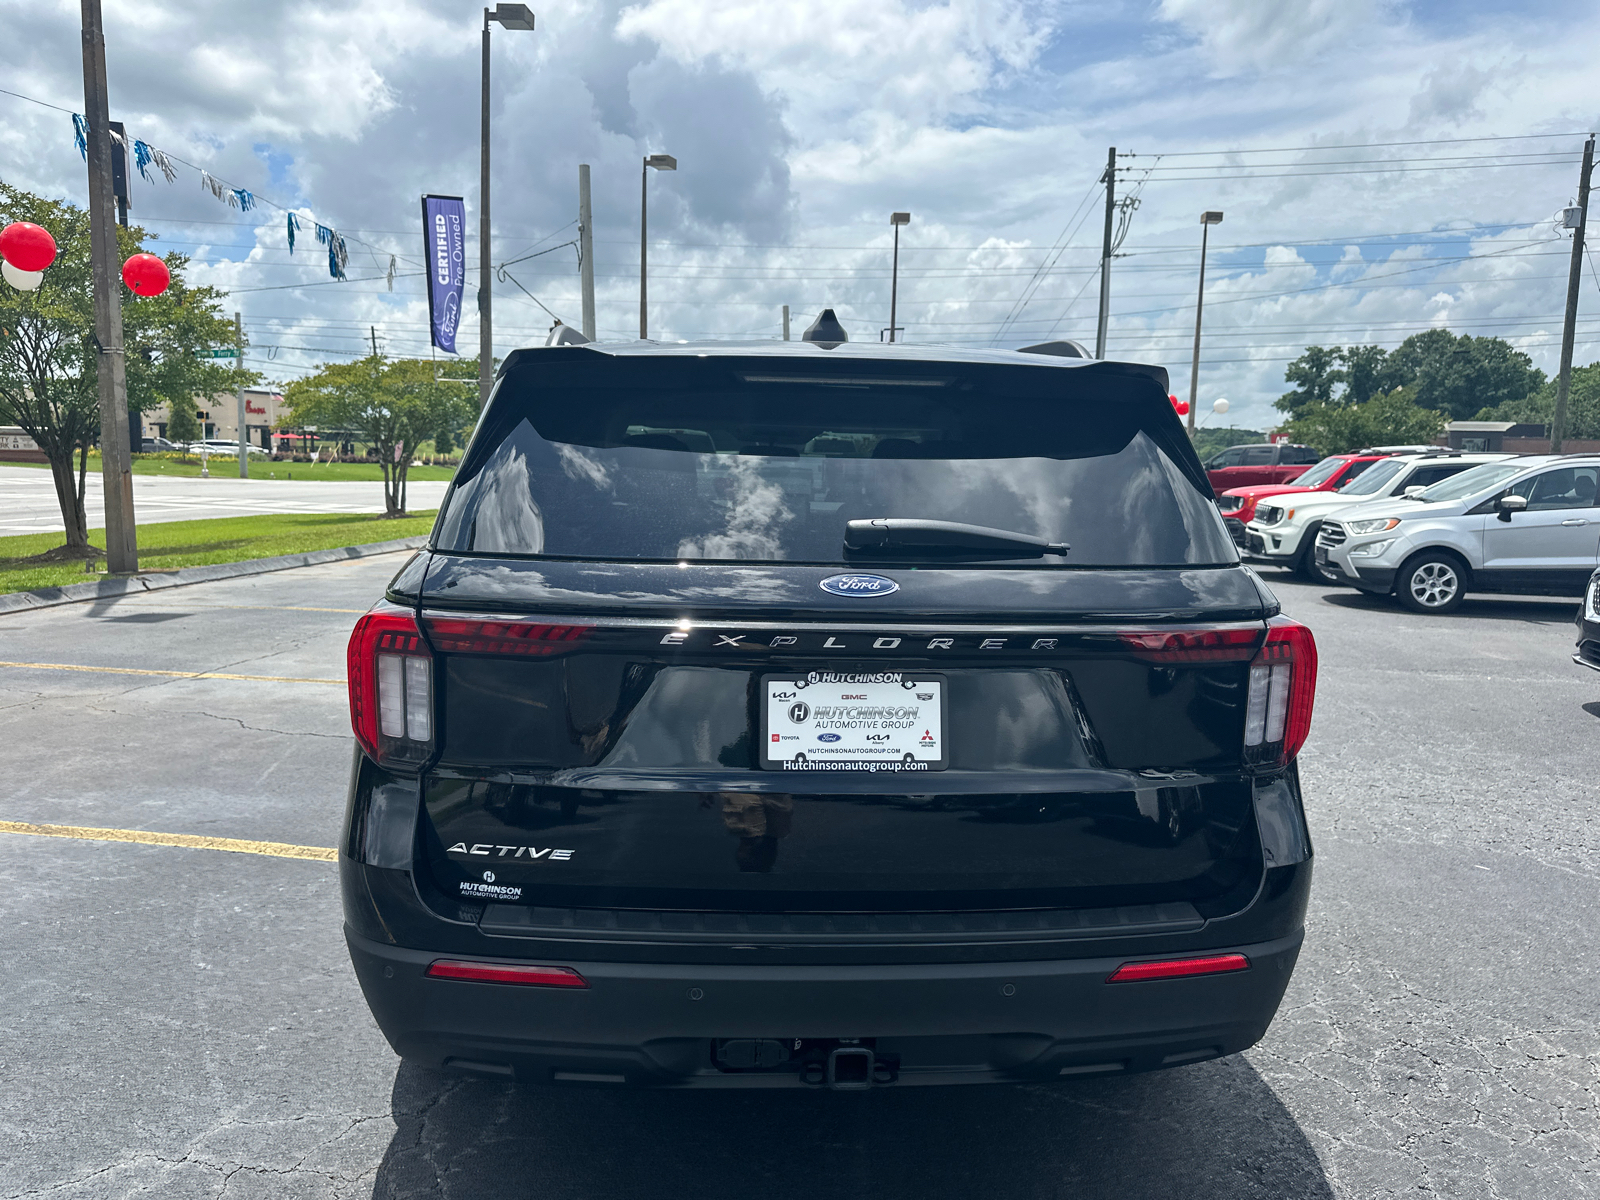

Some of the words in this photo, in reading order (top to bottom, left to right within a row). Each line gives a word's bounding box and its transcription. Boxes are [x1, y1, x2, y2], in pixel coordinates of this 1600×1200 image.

[435, 214, 450, 285] CERTIFIED
[449, 214, 463, 287] Pre-Owned
[444, 303, 458, 337] Ford
[837, 576, 881, 592] Ford
[659, 632, 1060, 651] EXPLORER
[822, 672, 903, 684] HUTCHINSON
[813, 705, 920, 720] HUTCHINSON
[815, 720, 879, 729] AUTOMOTIVE
[881, 720, 915, 729] GROUP
[821, 734, 837, 742] Ford
[783, 760, 928, 773] Hutchinsonautogroup.com
[446, 842, 576, 861] ACTIVE
[459, 881, 522, 895] HUTCHINSON
[460, 890, 498, 899] AUTOMOTIVE
